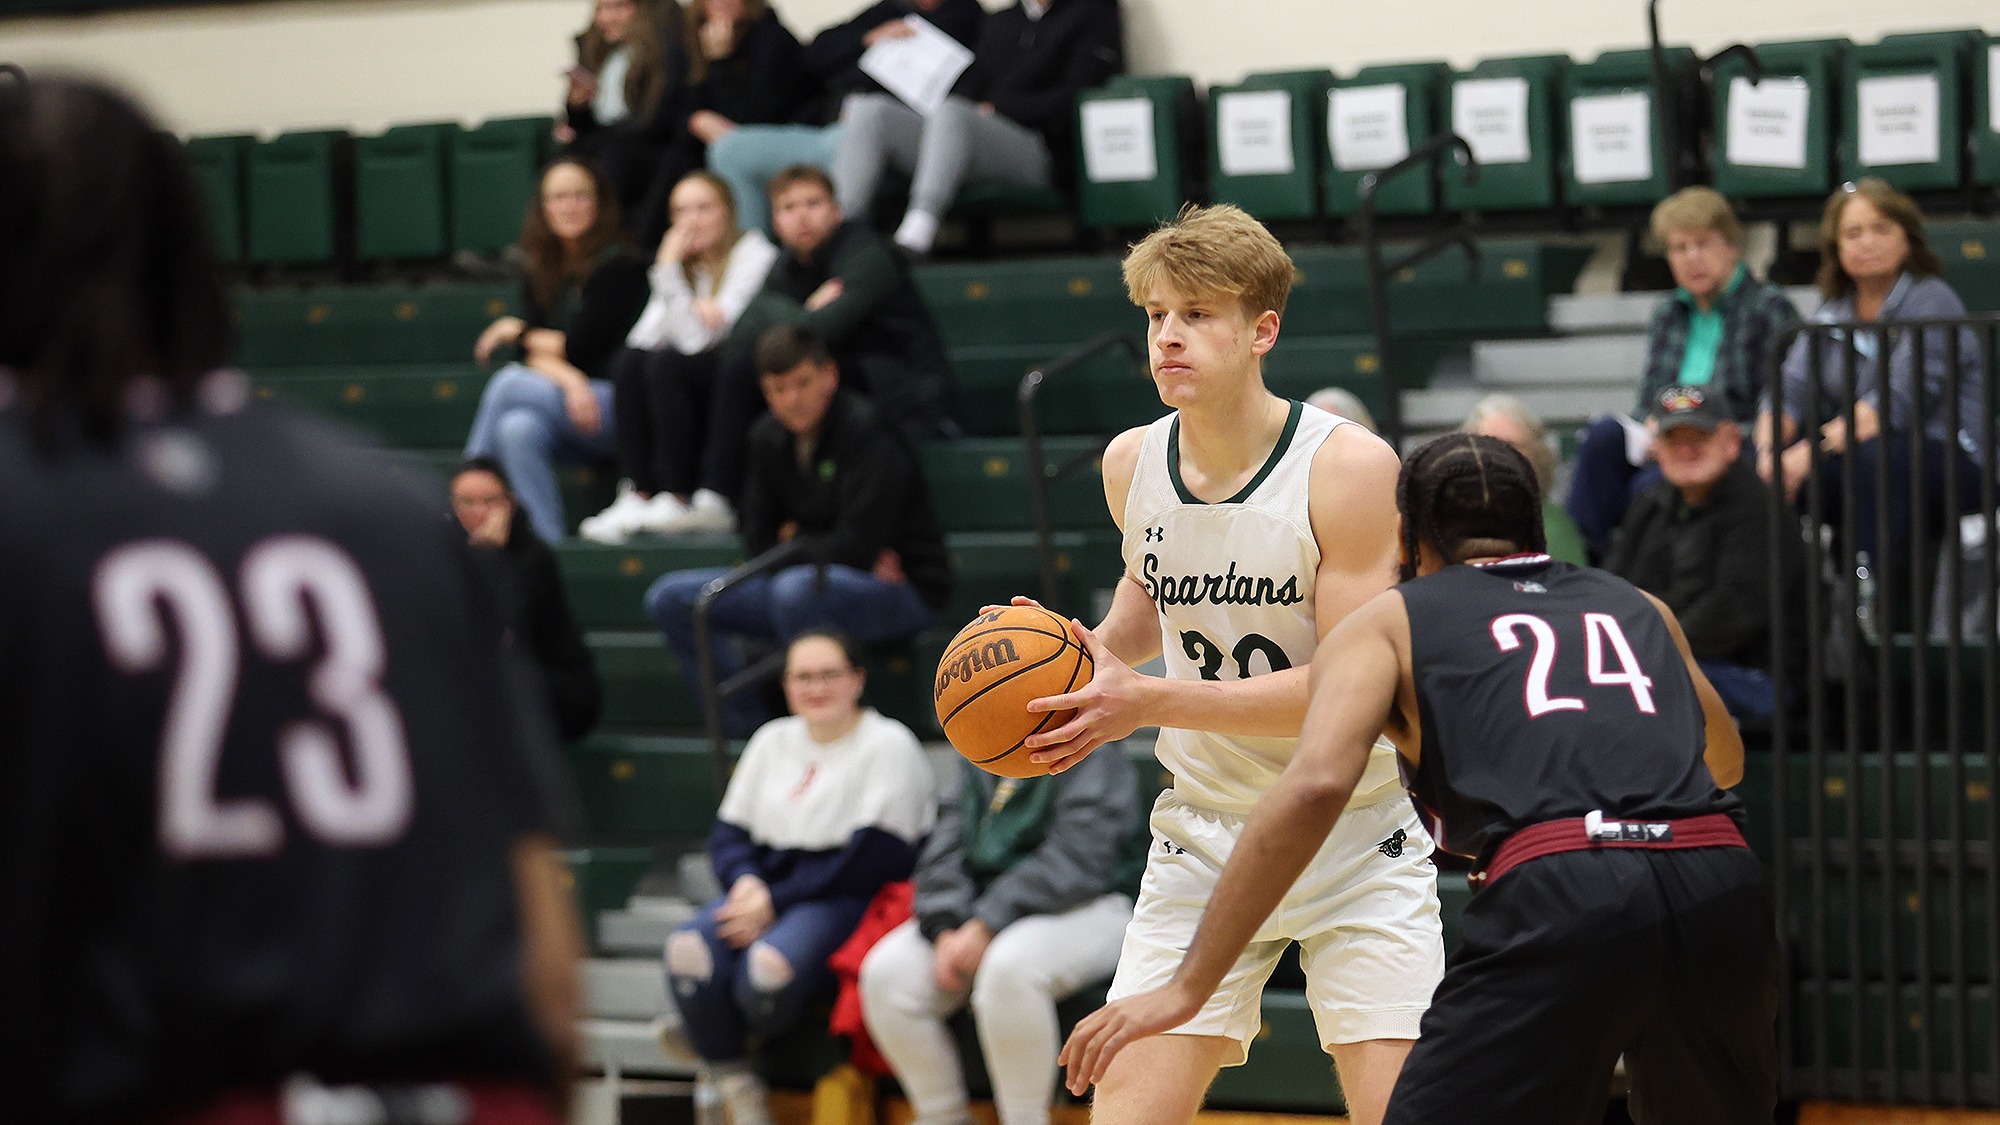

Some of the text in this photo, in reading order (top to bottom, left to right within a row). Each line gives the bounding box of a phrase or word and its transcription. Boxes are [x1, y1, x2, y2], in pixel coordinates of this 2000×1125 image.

[1143, 552, 1304, 617] Spartans
[93, 535, 415, 860] 23
[934, 637, 1020, 702] Wilson
[1489, 612, 1658, 720] 24
